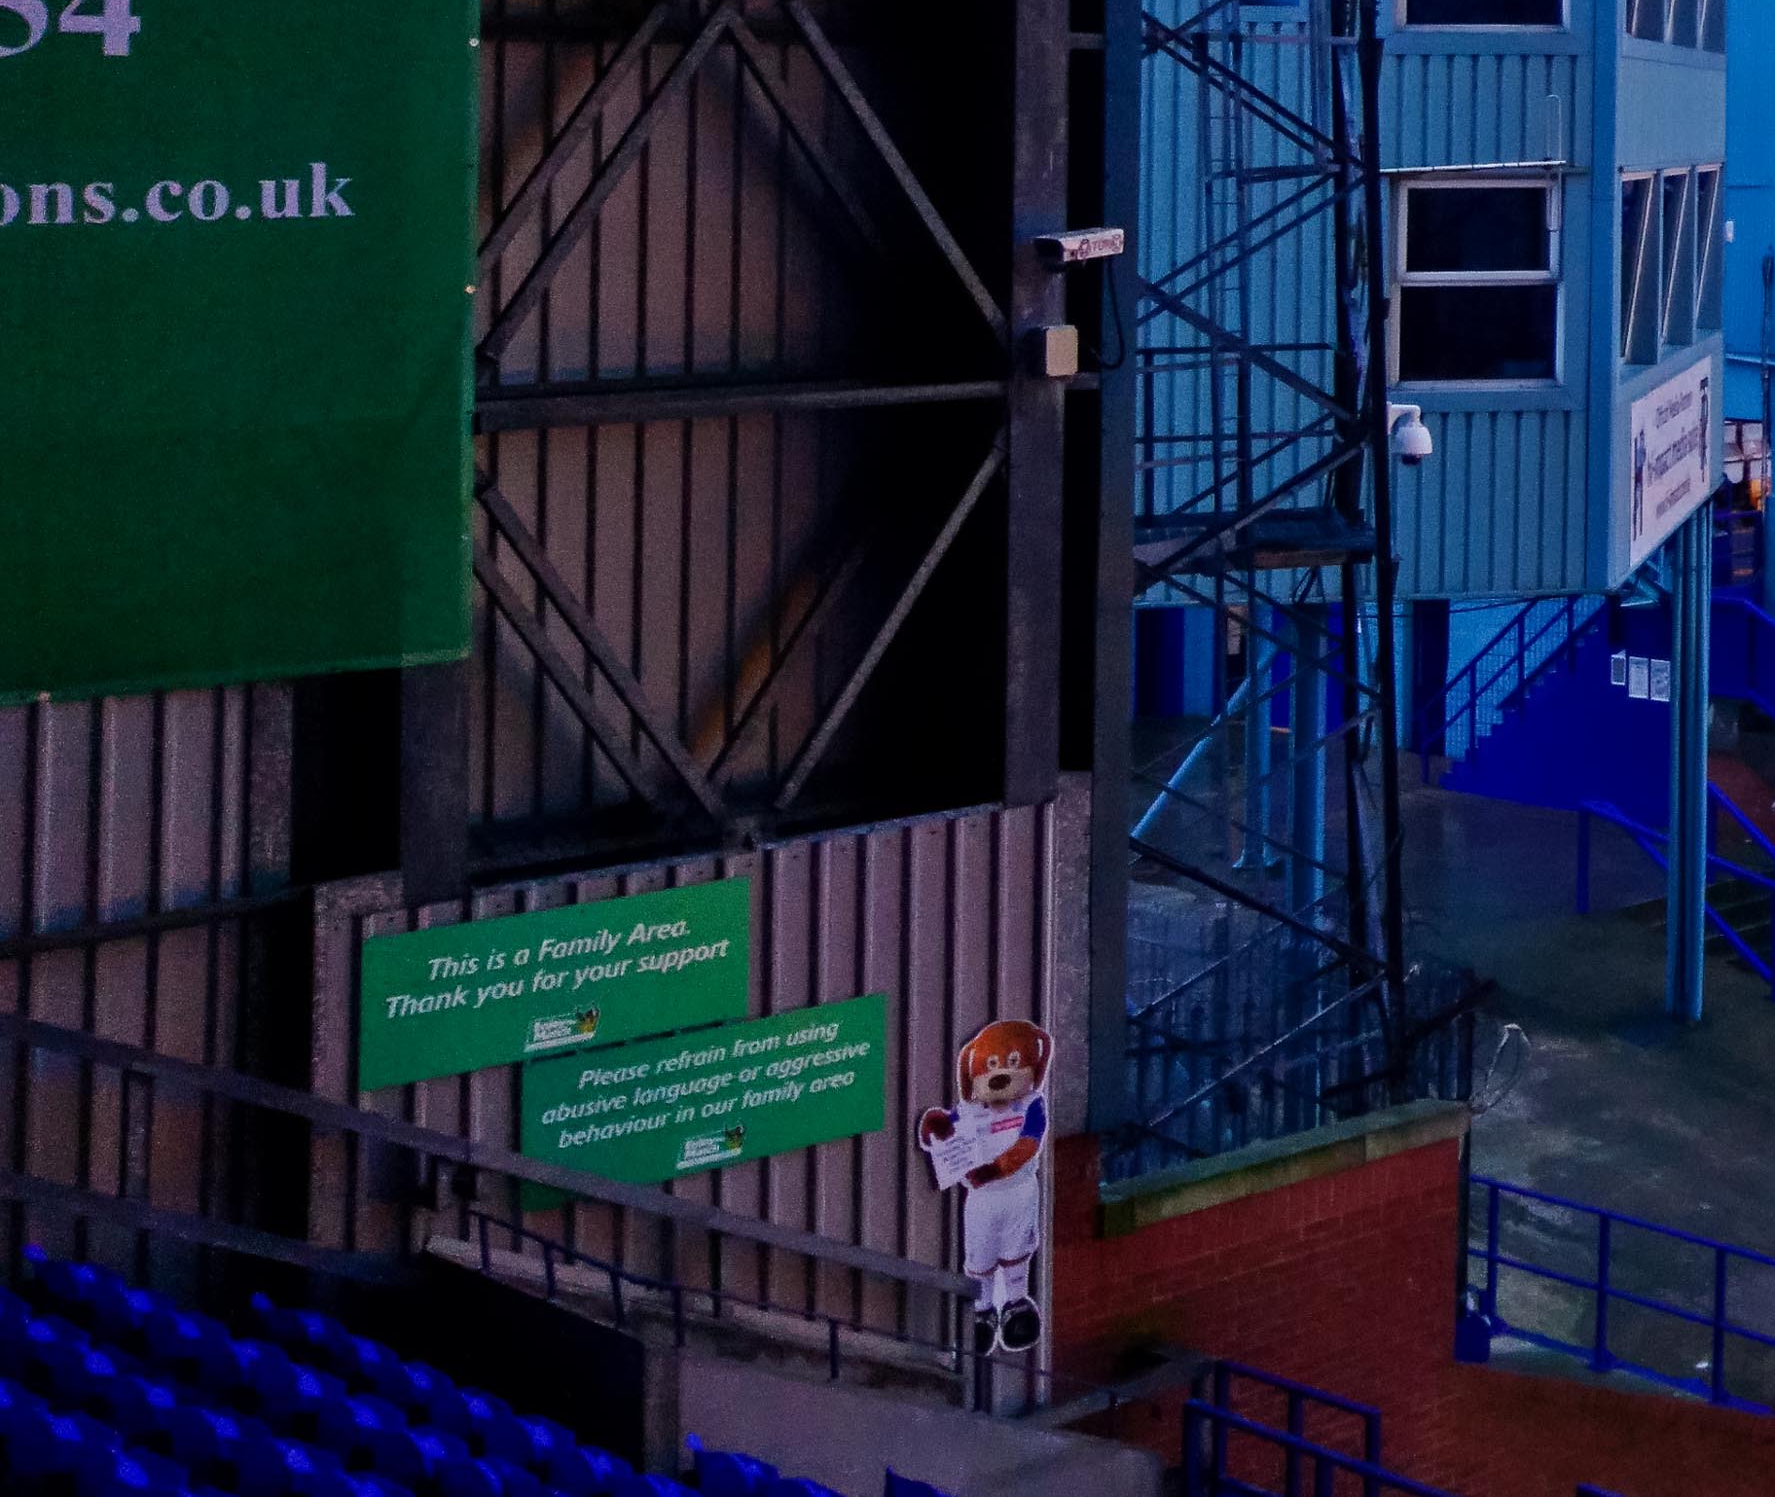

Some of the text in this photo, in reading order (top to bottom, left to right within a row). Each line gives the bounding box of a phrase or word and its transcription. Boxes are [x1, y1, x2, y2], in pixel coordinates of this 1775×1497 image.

[386, 939, 730, 1019] Thank you for your support
[429, 952, 480, 982] This
[487, 948, 506, 971] is
[512, 948, 531, 966] a
[538, 928, 621, 962] Family
[542, 1041, 871, 1125] abusive language or aggressive
[577, 1021, 844, 1090] Please refrain from using
[558, 1111, 672, 1148] behaviour
[676, 1104, 695, 1122] in
[701, 1097, 738, 1118] our
[741, 1079, 802, 1109] family
[809, 1069, 855, 1093] area
